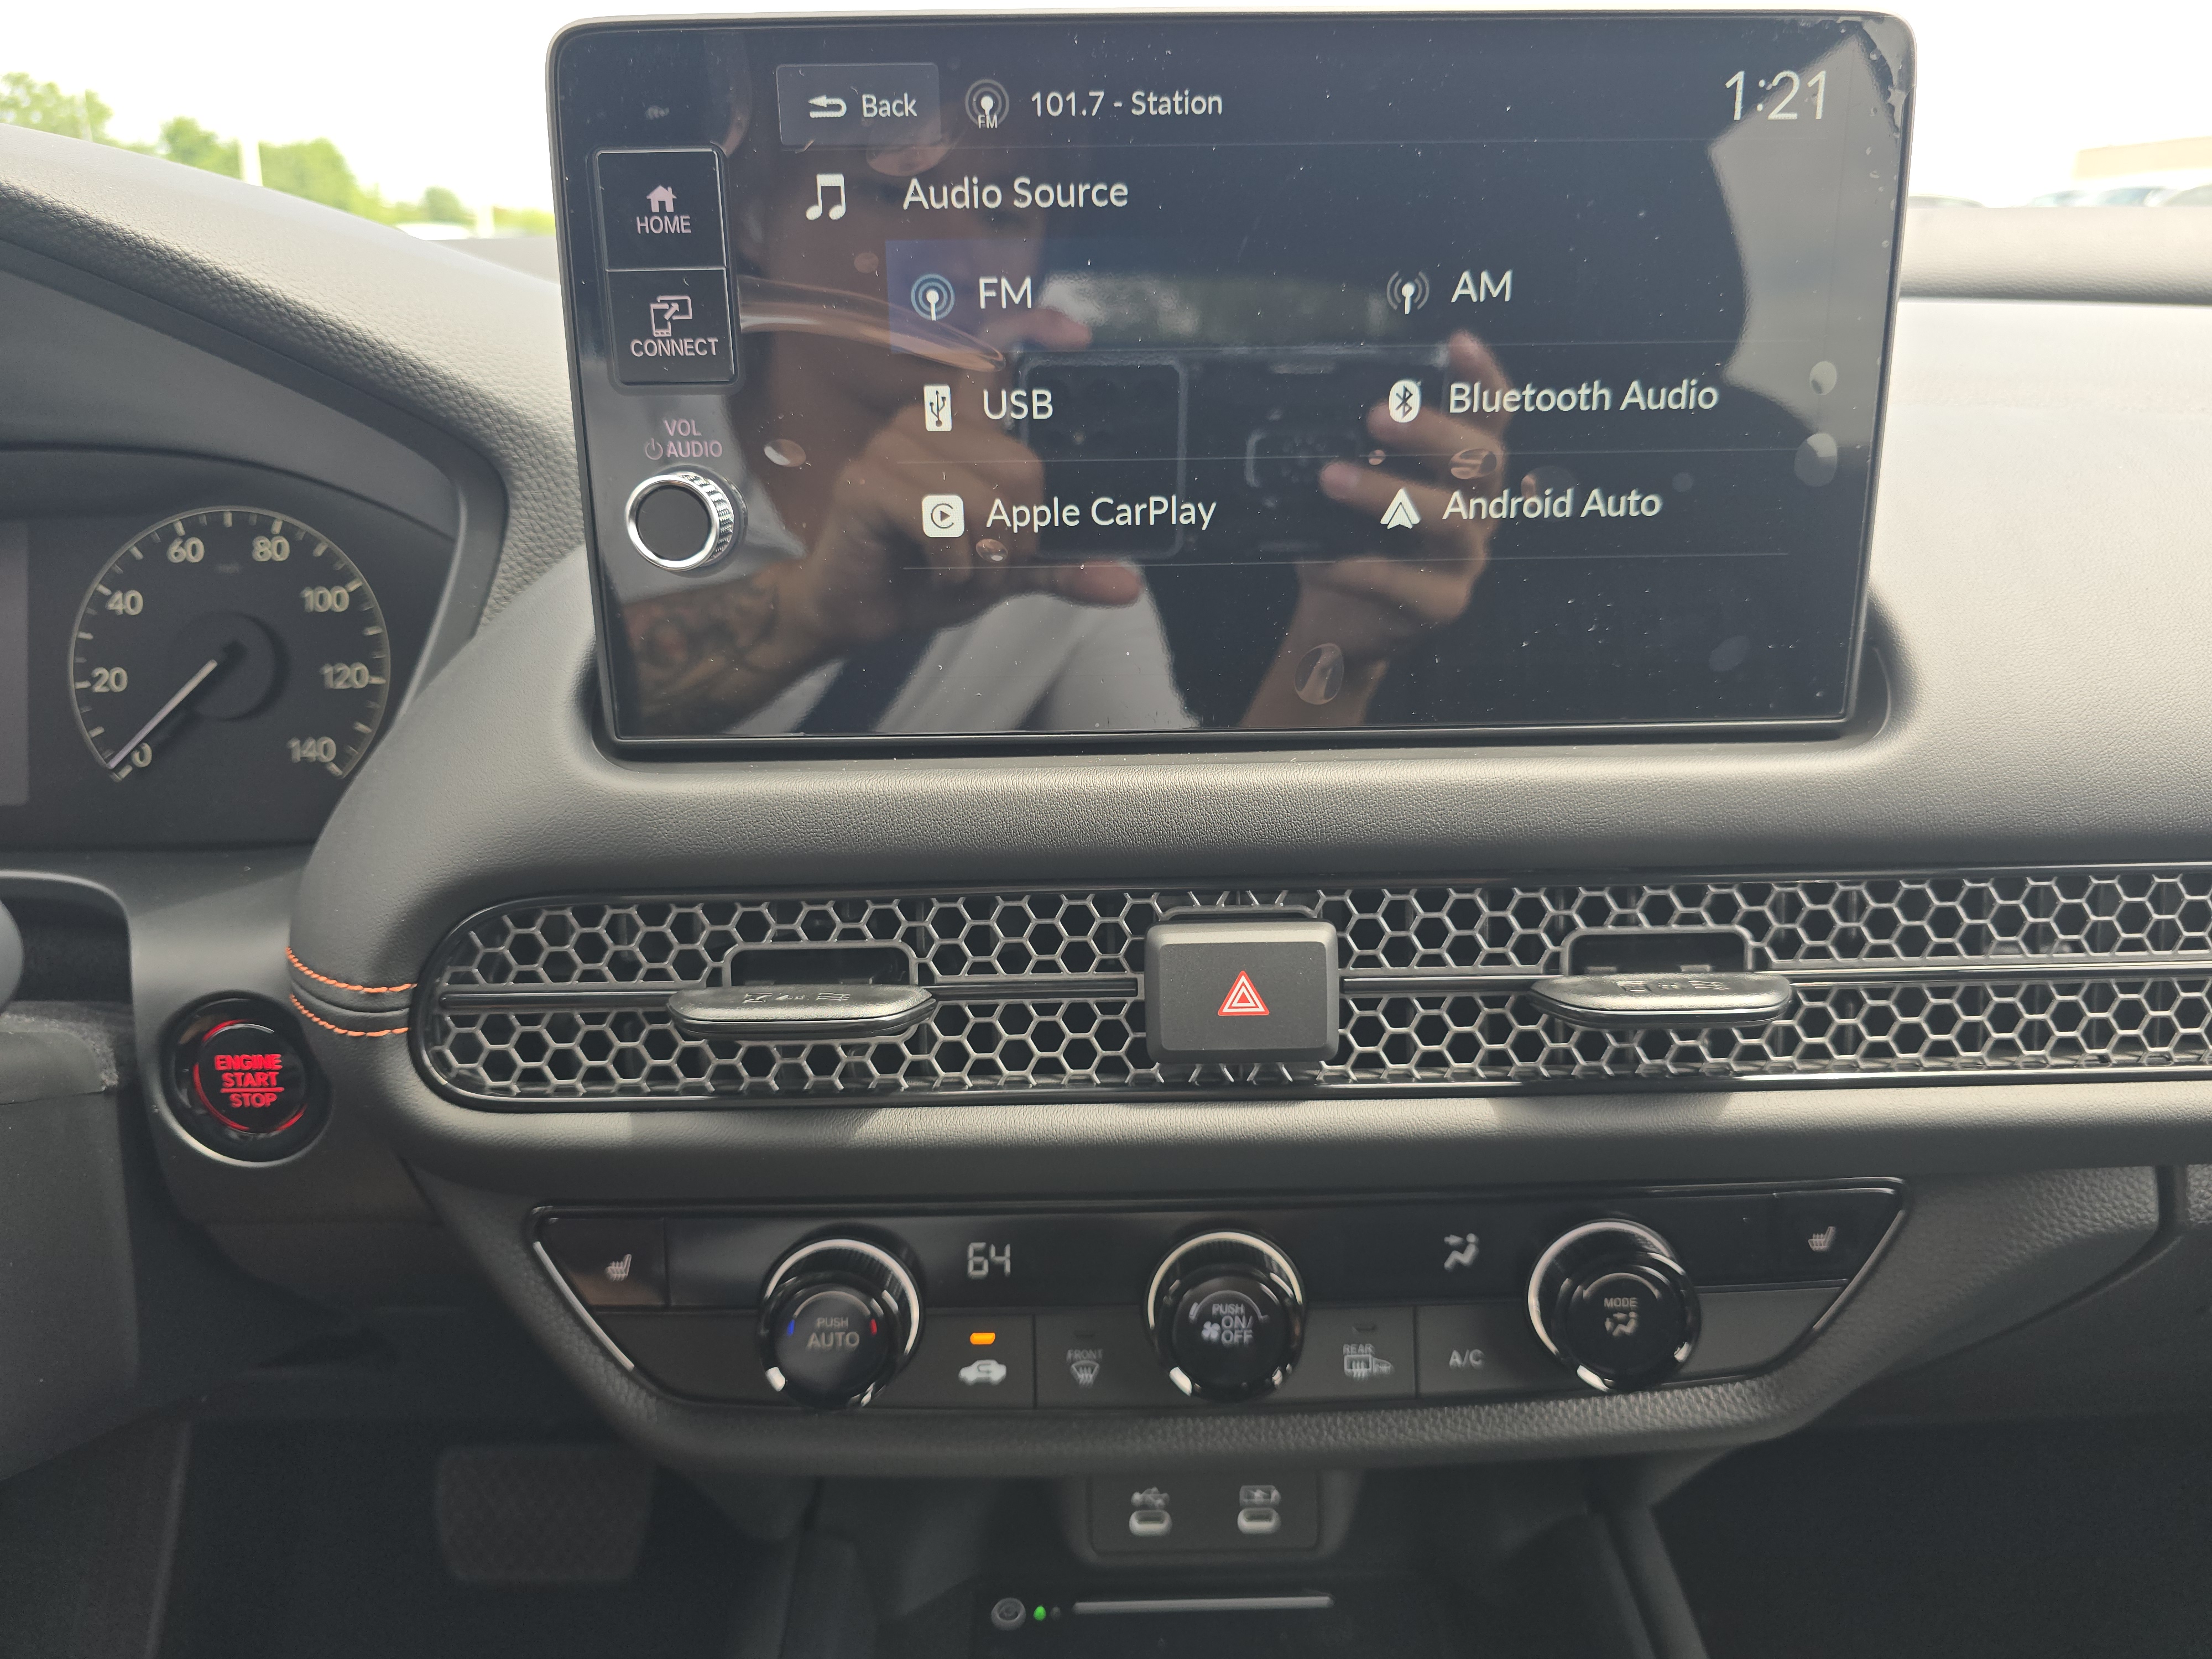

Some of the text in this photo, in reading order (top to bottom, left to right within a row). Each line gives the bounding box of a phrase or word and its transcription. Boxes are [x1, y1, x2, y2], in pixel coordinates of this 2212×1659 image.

[862, 93, 918, 118] Back
[1031, 91, 1103, 117] 101.7
[1131, 90, 1223, 117] Station
[1724, 70, 1828, 121] 1:21
[978, 114, 998, 129] FM
[903, 176, 1129, 212] Audio Source
[636, 215, 692, 234] HOME
[978, 276, 1033, 310] FM
[1451, 269, 1514, 304] AM
[630, 337, 719, 357] CONNECT
[982, 389, 1055, 420] USB
[1449, 379, 1719, 414] Bluetooth Audio
[664, 419, 702, 437] VOL
[666, 440, 723, 458] AUDIO
[986, 494, 1217, 533] Apple CarPlay
[1442, 486, 1663, 521] Android Auto
[167, 536, 205, 563] 60
[252, 535, 290, 562] 80
[107, 589, 143, 615] 40
[300, 586, 349, 612] 100
[91, 666, 128, 692] 20
[320, 662, 370, 690] 120
[131, 743, 152, 768] 0
[288, 737, 337, 764] 140
[214, 1053, 283, 1071] ENGINE
[221, 1071, 279, 1088] START
[229, 1093, 278, 1108] STOP
[967, 1241, 1011, 1279] 64
[1212, 1303, 1244, 1316] PUSH
[1604, 1296, 1637, 1308] MODE
[816, 1317, 849, 1330] PUSH
[1221, 1315, 1253, 1330] ON/
[806, 1331, 860, 1350] AUTO
[1221, 1328, 1254, 1345] OFF
[1066, 1348, 1103, 1361] FRONT
[1343, 1344, 1374, 1355] REAR
[1449, 1349, 1485, 1369] A/C
